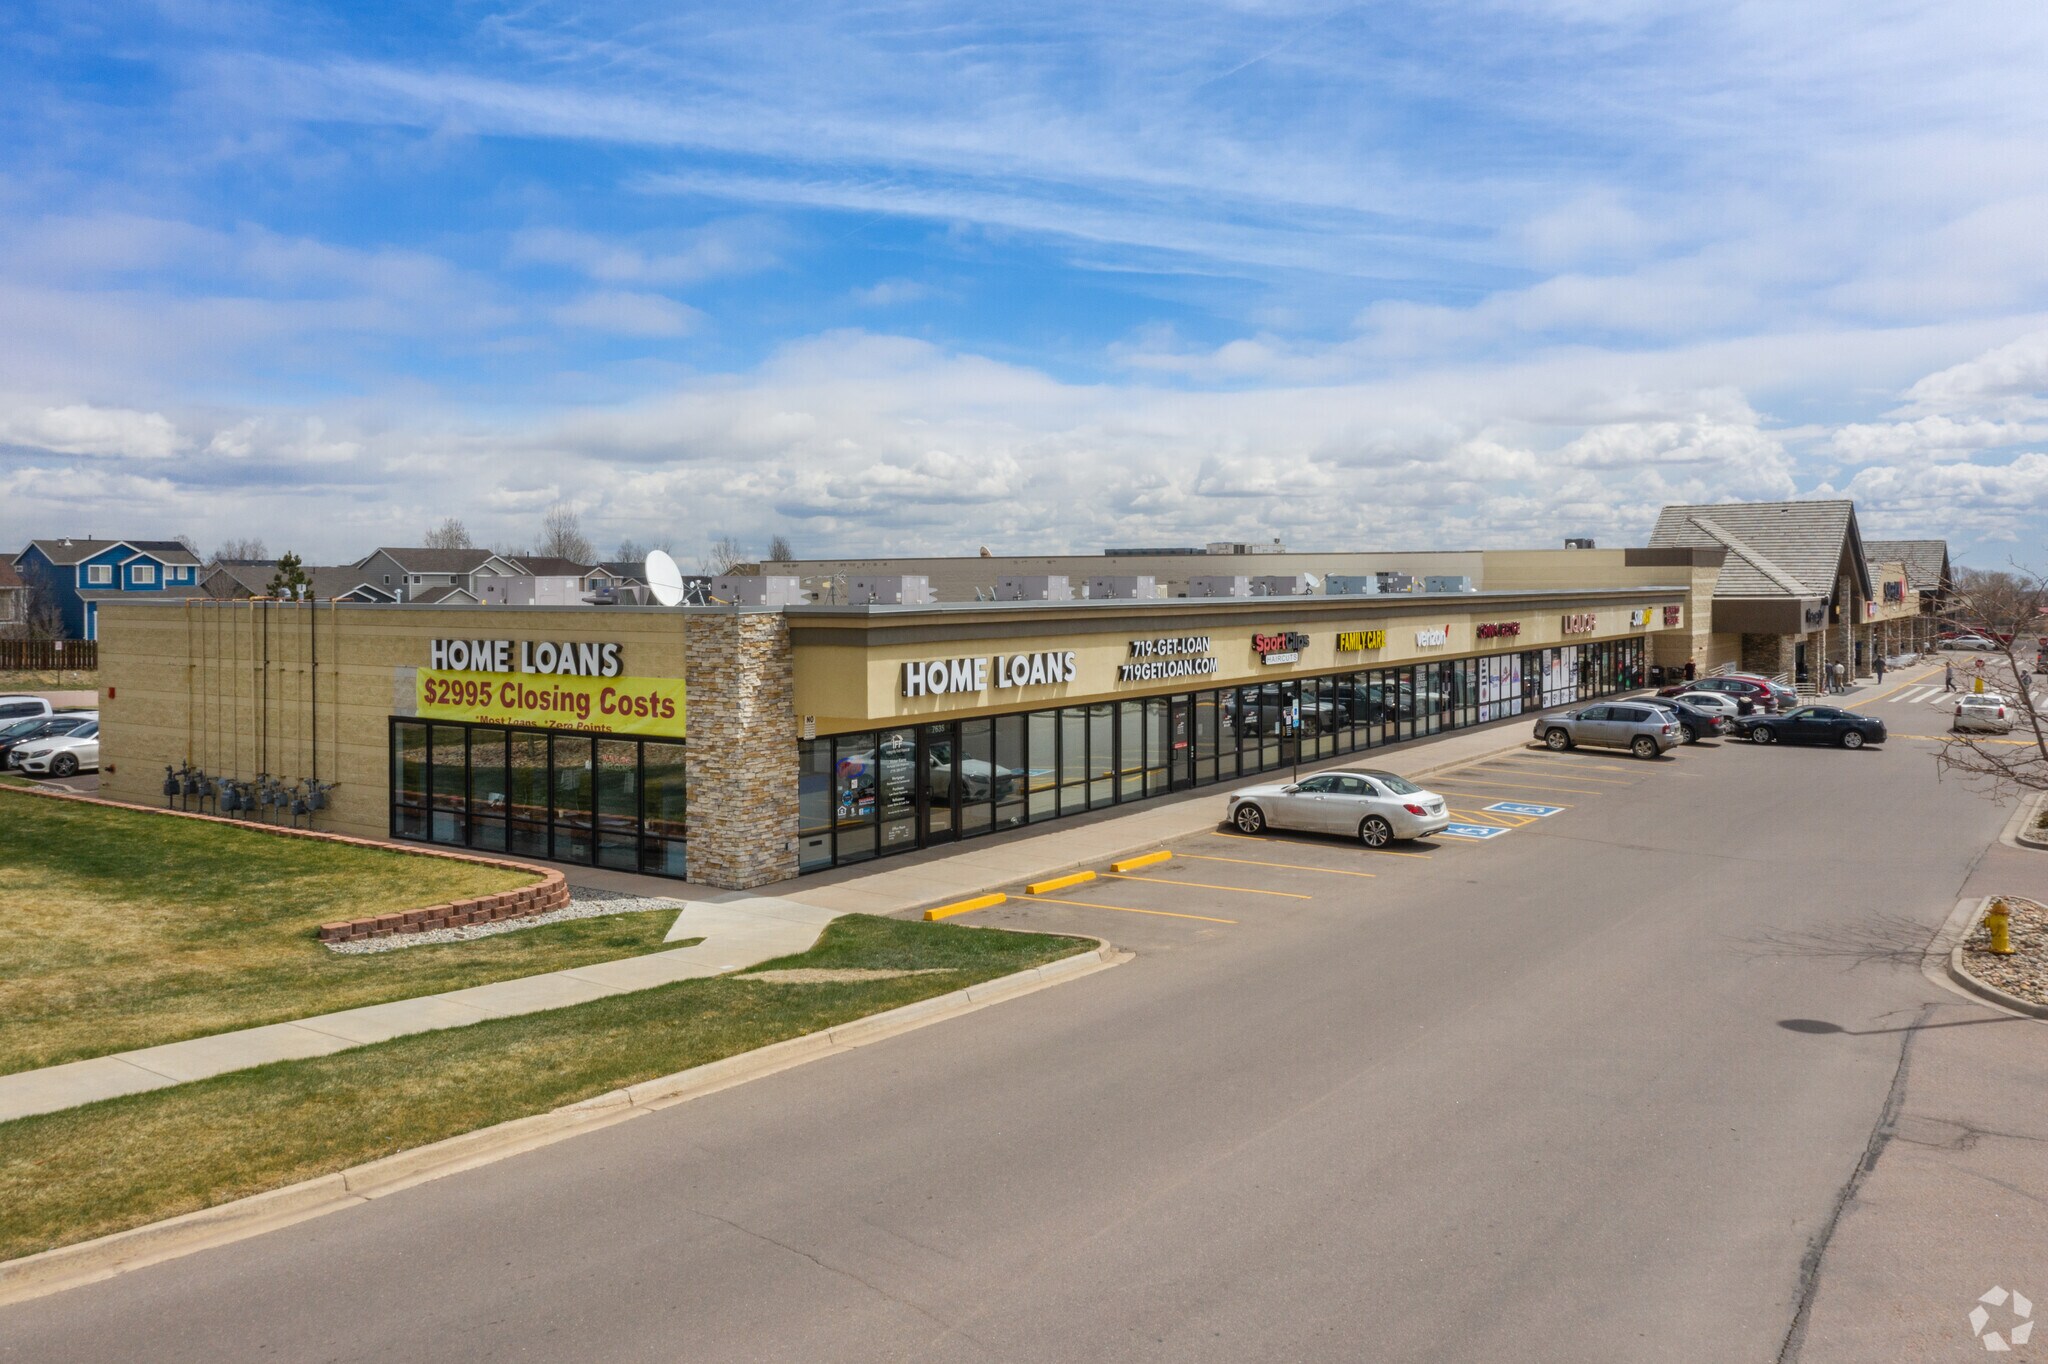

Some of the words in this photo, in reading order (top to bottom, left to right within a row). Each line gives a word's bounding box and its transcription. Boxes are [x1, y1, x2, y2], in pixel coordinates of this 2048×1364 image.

[1133, 637, 1210, 657] 719-GET-LOAN
[1340, 632, 1366, 651] FAMILY
[1367, 630, 1386, 649] CARE
[1416, 629, 1446, 647] verizon
[431, 639, 509, 672] HOME
[521, 641, 619, 677] LOANS
[1266, 653, 1298, 663] HAIRCUTS
[906, 657, 987, 697] HOME
[998, 652, 1077, 688] LOANS
[1123, 658, 1217, 681] 719GETLOAN.COM
[424, 677, 492, 707] $2995
[500, 682, 591, 720] Closing
[600, 687, 675, 719] Costs
[577, 721, 612, 732] Points
